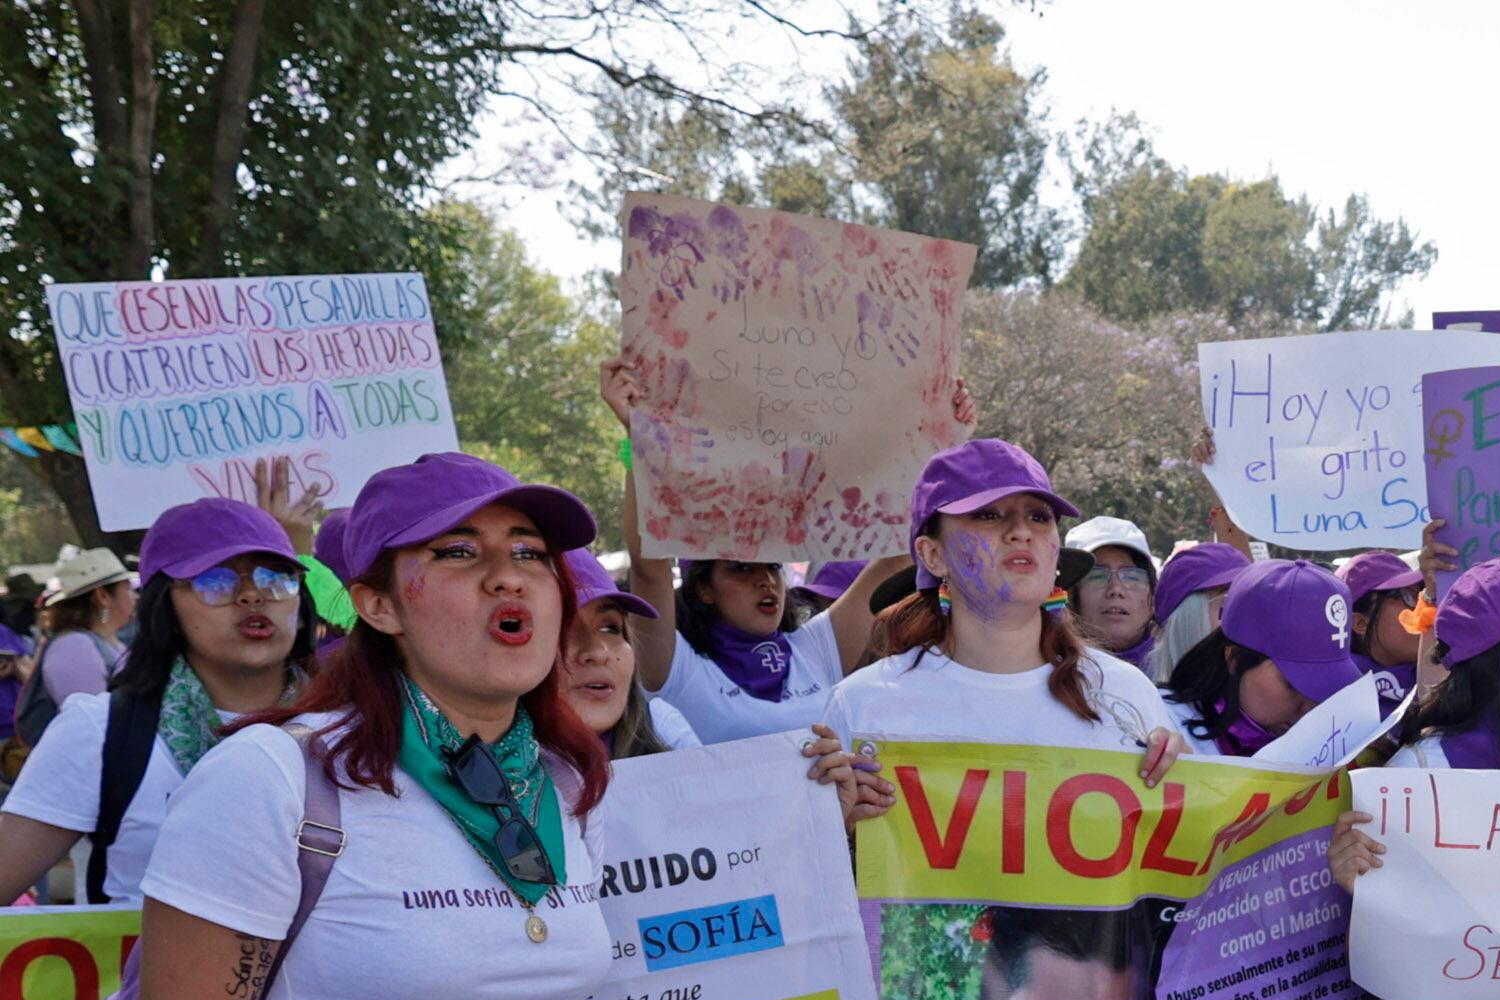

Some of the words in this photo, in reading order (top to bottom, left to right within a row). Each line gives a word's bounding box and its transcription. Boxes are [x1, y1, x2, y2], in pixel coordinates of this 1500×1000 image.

[56, 291, 121, 343] QUE
[121, 286, 213, 334] CESEN
[213, 285, 273, 326] LAS
[272, 276, 428, 326] PESADILLAS
[738, 296, 816, 345] Luna
[70, 341, 251, 399] CICATRICEN
[252, 336, 309, 377] LAS
[316, 324, 433, 371] HERIDAS
[752, 353, 790, 386] te
[793, 366, 857, 391] creo
[80, 412, 106, 459] Y
[314, 389, 338, 435] A
[332, 379, 439, 429] TODAS
[1345, 384, 1391, 431] yo
[1245, 436, 1277, 483] el
[1321, 430, 1407, 500] grito
[1271, 494, 1368, 534] Luna
[728, 845, 761, 871] por
[1218, 861, 1260, 893] VENDE
[1264, 886, 1286, 905] en
[642, 906, 778, 959] SOFÍA
[1219, 926, 1266, 958] como
[1270, 922, 1286, 940] el
[1289, 902, 1341, 934] Matón
[1207, 955, 1284, 994] sexualmente
[1286, 946, 1301, 963] de
[1260, 982, 1276, 998] en
[1291, 952, 1346, 987] actualidad
